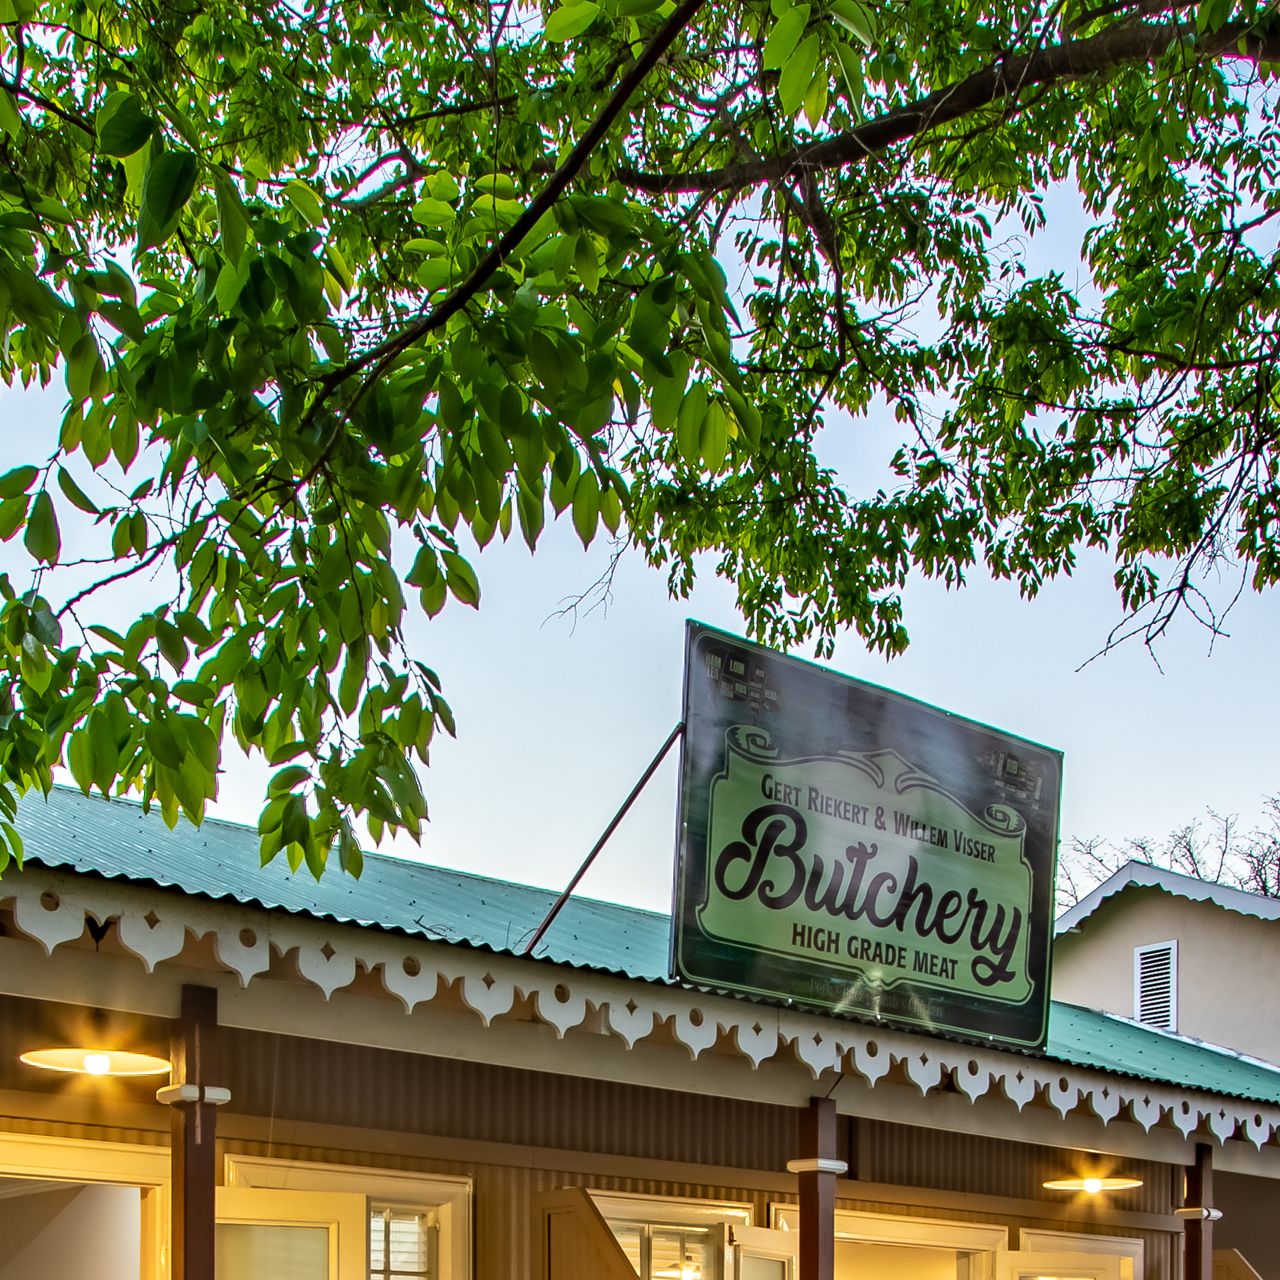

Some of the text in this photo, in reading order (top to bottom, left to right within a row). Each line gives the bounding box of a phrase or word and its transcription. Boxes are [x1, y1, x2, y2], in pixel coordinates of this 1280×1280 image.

[761, 773, 996, 864] GERT RIEKERT & WILLEM VISSER
[714, 804, 1021, 987] Butchery
[791, 923, 958, 980] HIGH GRADE MEAT
